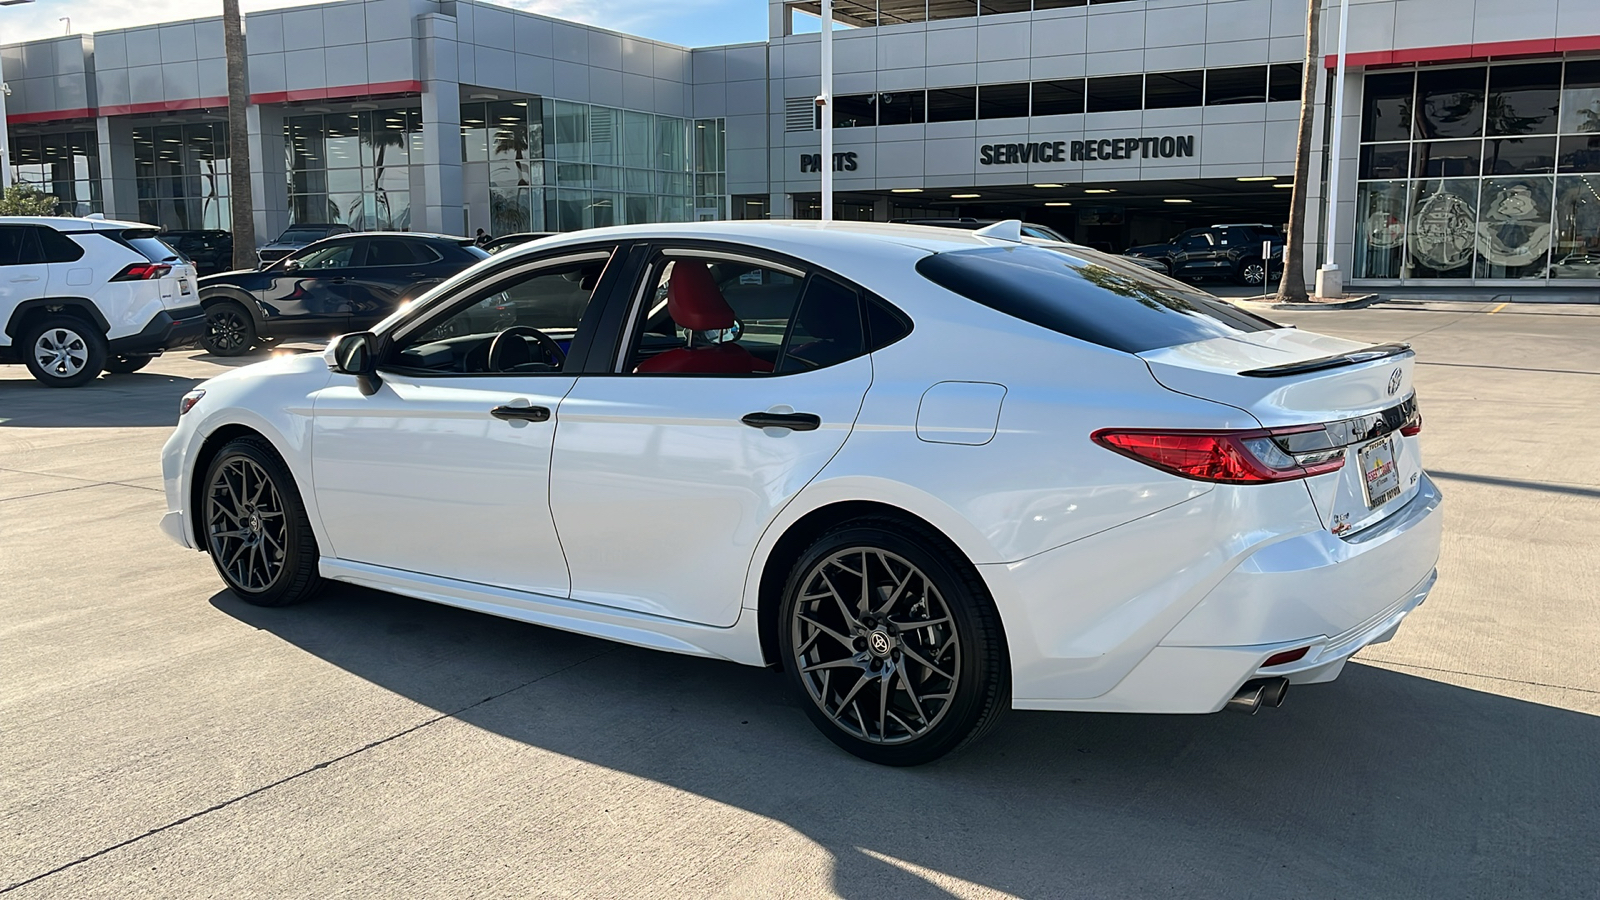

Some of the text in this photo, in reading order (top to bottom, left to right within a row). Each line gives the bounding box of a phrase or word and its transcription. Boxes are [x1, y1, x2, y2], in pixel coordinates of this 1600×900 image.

[800, 152, 858, 173] PATS
[979, 135, 1194, 165] SERVICE RECEPTION
